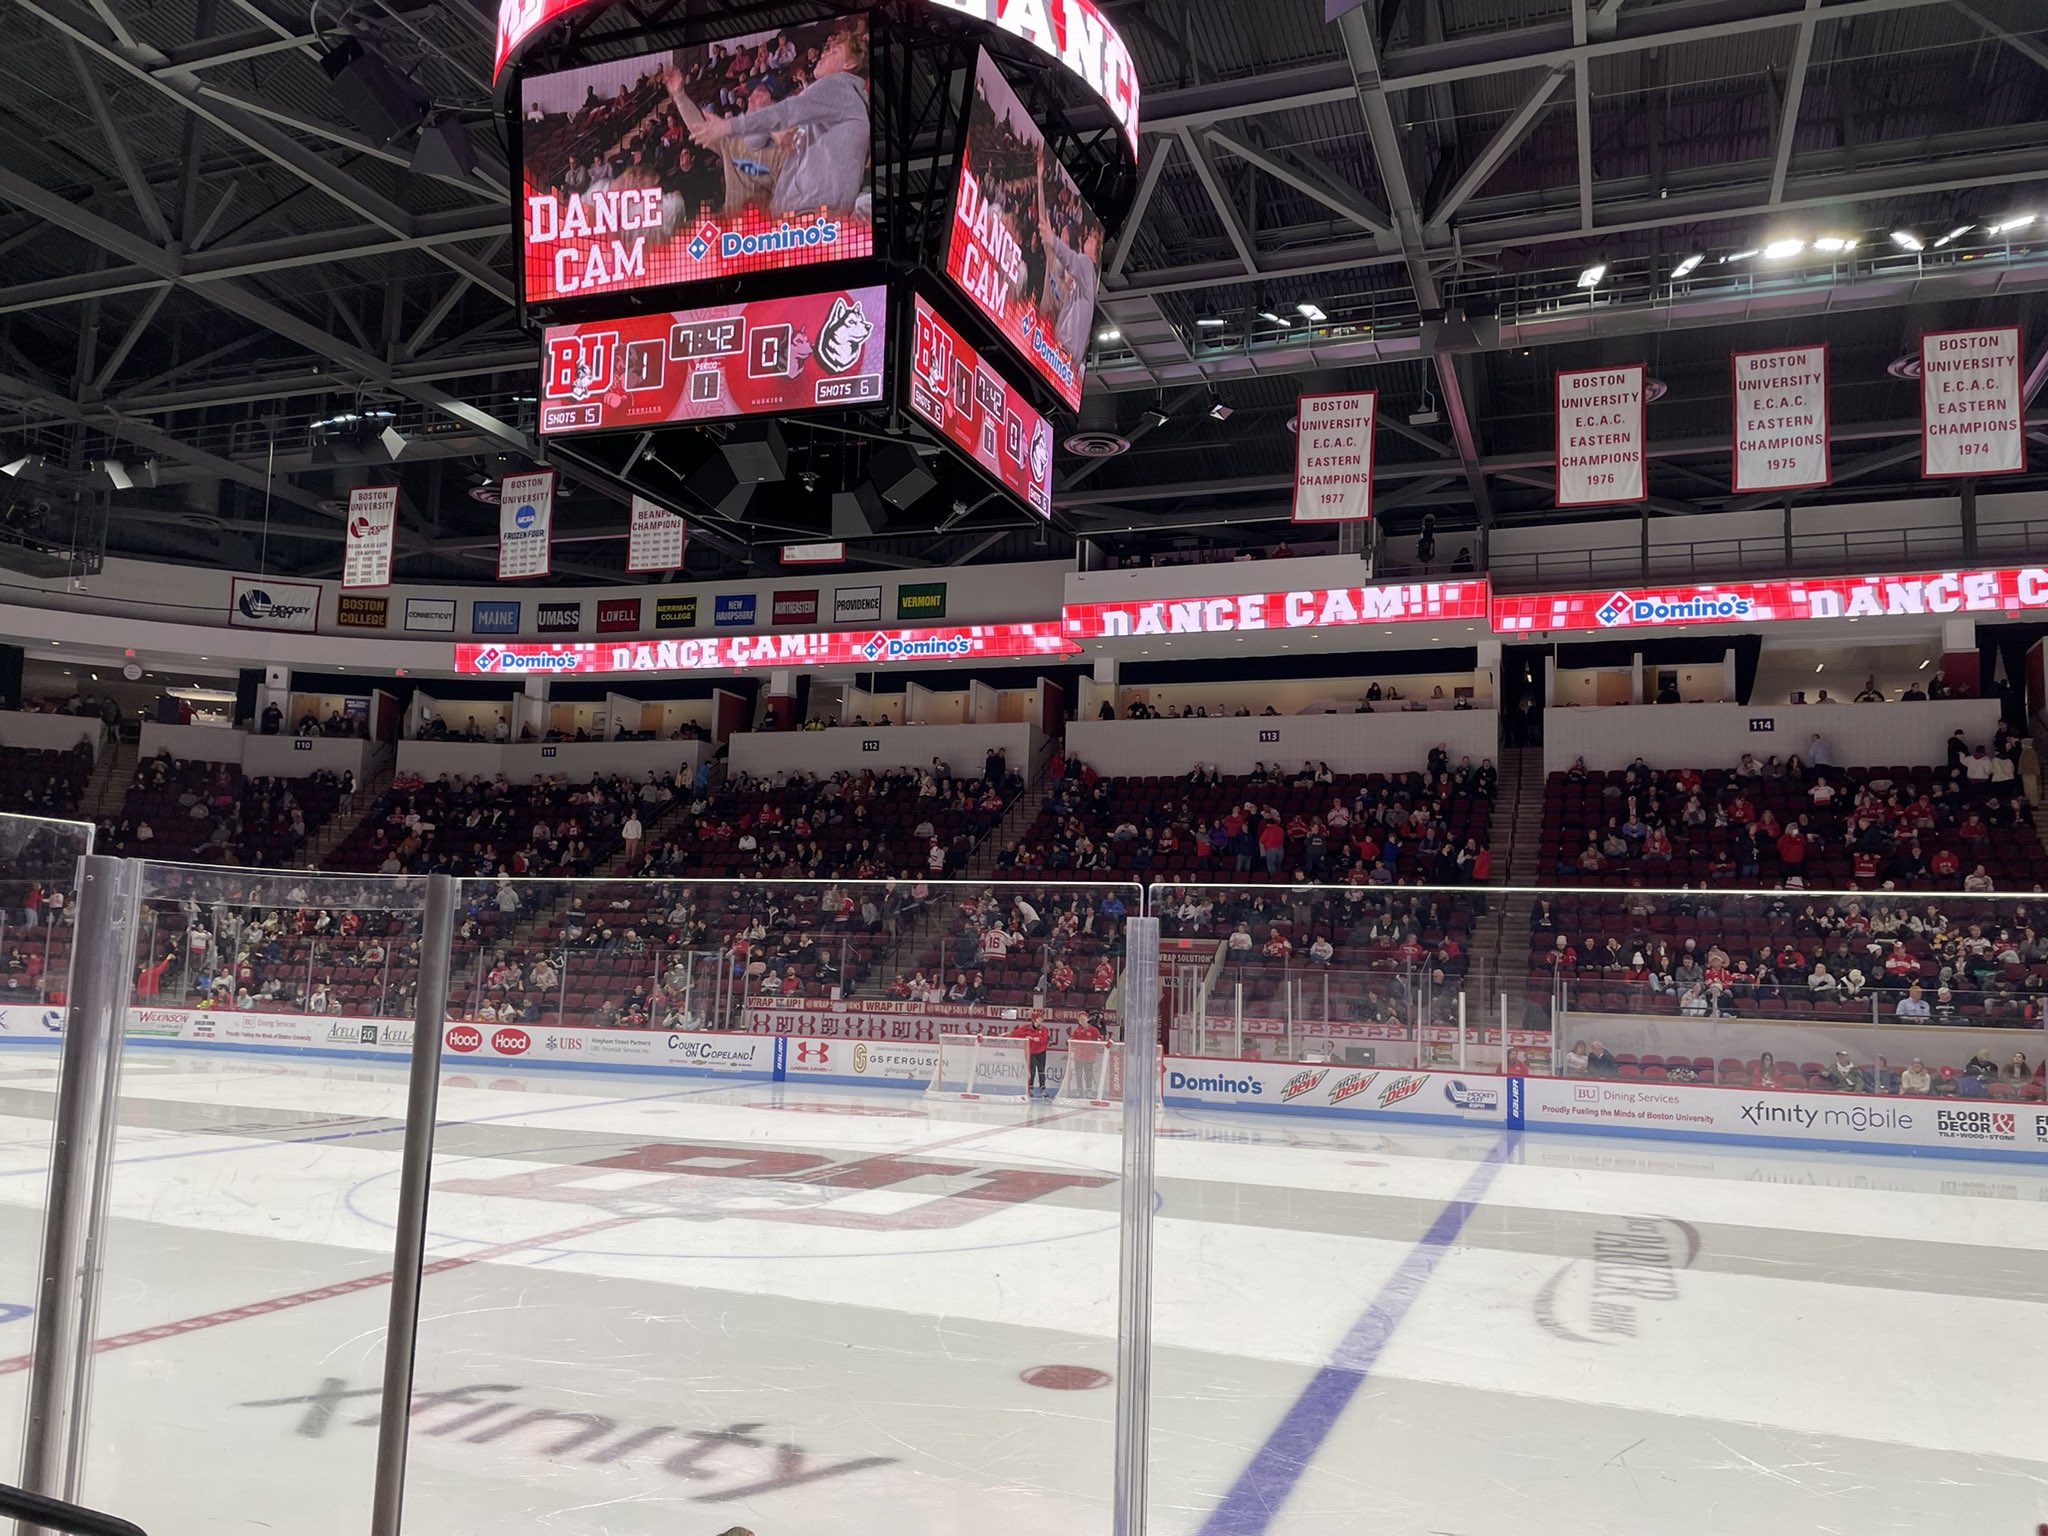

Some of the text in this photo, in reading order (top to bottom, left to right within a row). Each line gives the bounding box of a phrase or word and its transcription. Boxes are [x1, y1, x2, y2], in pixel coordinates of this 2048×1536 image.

[528, 188, 663, 243] DANCE
[958, 168, 1022, 285] DANCE
[722, 218, 838, 258] Domino's
[555, 236, 647, 293] CAM
[963, 242, 1009, 319] CAM
[679, 325, 735, 355] 7:42
[1939, 336, 1999, 351] BOSTON
[762, 337, 779, 367] 0
[914, 308, 953, 397] BU
[1032, 328, 1074, 387] Domino's
[547, 332, 618, 398] BU
[641, 352, 648, 380] 1
[1750, 355, 1806, 370] BOSTON
[1927, 355, 2015, 372] UNIVERSITY
[704, 376, 709, 397] 1
[819, 380, 869, 397] SHOTS 6
[1573, 374, 1625, 389] BOSTON
[1738, 373, 1822, 391] UNIVERSITY
[1943, 378, 1999, 393] E.C.A.C.
[914, 390, 931, 412] SHOTS
[978, 377, 1002, 416] 7:42
[1561, 392, 1639, 409] UNIVERSITY
[1753, 395, 1807, 410] E.C.A.C.
[1312, 400, 1359, 412] BOSTON
[1938, 399, 2007, 414] EASTERN
[547, 408, 595, 425] SHOTS 15
[1302, 417, 1370, 431] UNIVERSITY
[1576, 414, 1625, 427] E.C.A.C.
[1747, 415, 1813, 431] EASTERN
[1929, 419, 2017, 435] CHAMPIONS
[1010, 422, 1018, 451] 0
[1313, 437, 1357, 449] E.C.A.C.
[1570, 433, 1631, 447] EASTERN
[1739, 434, 1823, 451] CHAMPIONS
[1958, 443, 1989, 455] 1974
[1307, 455, 1361, 467] EASTERN
[1562, 452, 1639, 467] CHAMPIONS
[1767, 457, 1796, 470] 1975
[511, 478, 543, 489] BOSTON
[1300, 473, 1368, 486] CHAMPIONS
[1587, 473, 1614, 486] 1976
[358, 491, 388, 500] BOSTON
[502, 492, 549, 504] UNIVERSITY
[1321, 493, 1344, 504] 1977
[350, 501, 393, 511] UNIVERSITY
[632, 520, 681, 531] CHAMPIONS
[503, 529, 545, 540] FROZEN FOUR
[902, 595, 941, 607] VERMONT
[1633, 596, 1751, 619] Domino's
[1809, 574, 1999, 617] DANCE
[271, 604, 310, 613] HOCKEY
[342, 599, 384, 611] BOSTON
[657, 604, 696, 612] MERRIMACK
[728, 600, 743, 610] NEW
[774, 600, 815, 615] NORTHEASTERN
[836, 598, 879, 611] PROVIDENCE
[340, 612, 384, 625] COLLEGE
[478, 611, 515, 625] MAINE
[538, 610, 580, 625] UMASS
[600, 611, 636, 622] LOWELL
[661, 612, 691, 620] COLLEGE
[715, 610, 754, 621] HAMPSHIRE
[1098, 594, 1266, 636] DANCE
[501, 633, 970, 670] Domino's DANCE CAM!! Domino's
[1751, 720, 1771, 730] 114
[1260, 731, 1278, 742] 113
[296, 741, 311, 749] 110
[543, 748, 555, 756] 111
[864, 741, 879, 750] 112
[988, 937, 1000, 949] 16
[749, 997, 773, 1007] WRAP
[786, 998, 801, 1008] UP!
[866, 1001, 892, 1011] WRAP
[895, 1002, 904, 1011] IT
[907, 1002, 922, 1012] UP!
[139, 1011, 190, 1023] WILKINSON
[776, 1016, 794, 1034] BU
[892, 1021, 911, 1038] BU
[362, 1030, 374, 1040] 20
[449, 1032, 479, 1046] Hood
[495, 1034, 526, 1048] Hood
[668, 1034, 700, 1050] COUNT
[560, 1037, 582, 1050] UBS
[686, 1043, 756, 1060] ON COPELAND!
[869, 1055, 884, 1064] GS
[1170, 1072, 1263, 1095] Domino's
[1578, 1089, 1680, 1104] BU Dining Services
[1542, 1105, 1714, 1124] Proudly Fueling the Minds of Boston University
[1741, 1101, 1818, 1128] xfinity
[1937, 1110, 1990, 1122] FLOOR
[1938, 1121, 1991, 1133] DECOR
[1593, 1230, 1680, 1302] PARKER
[1590, 1301, 1638, 1338] RINK
